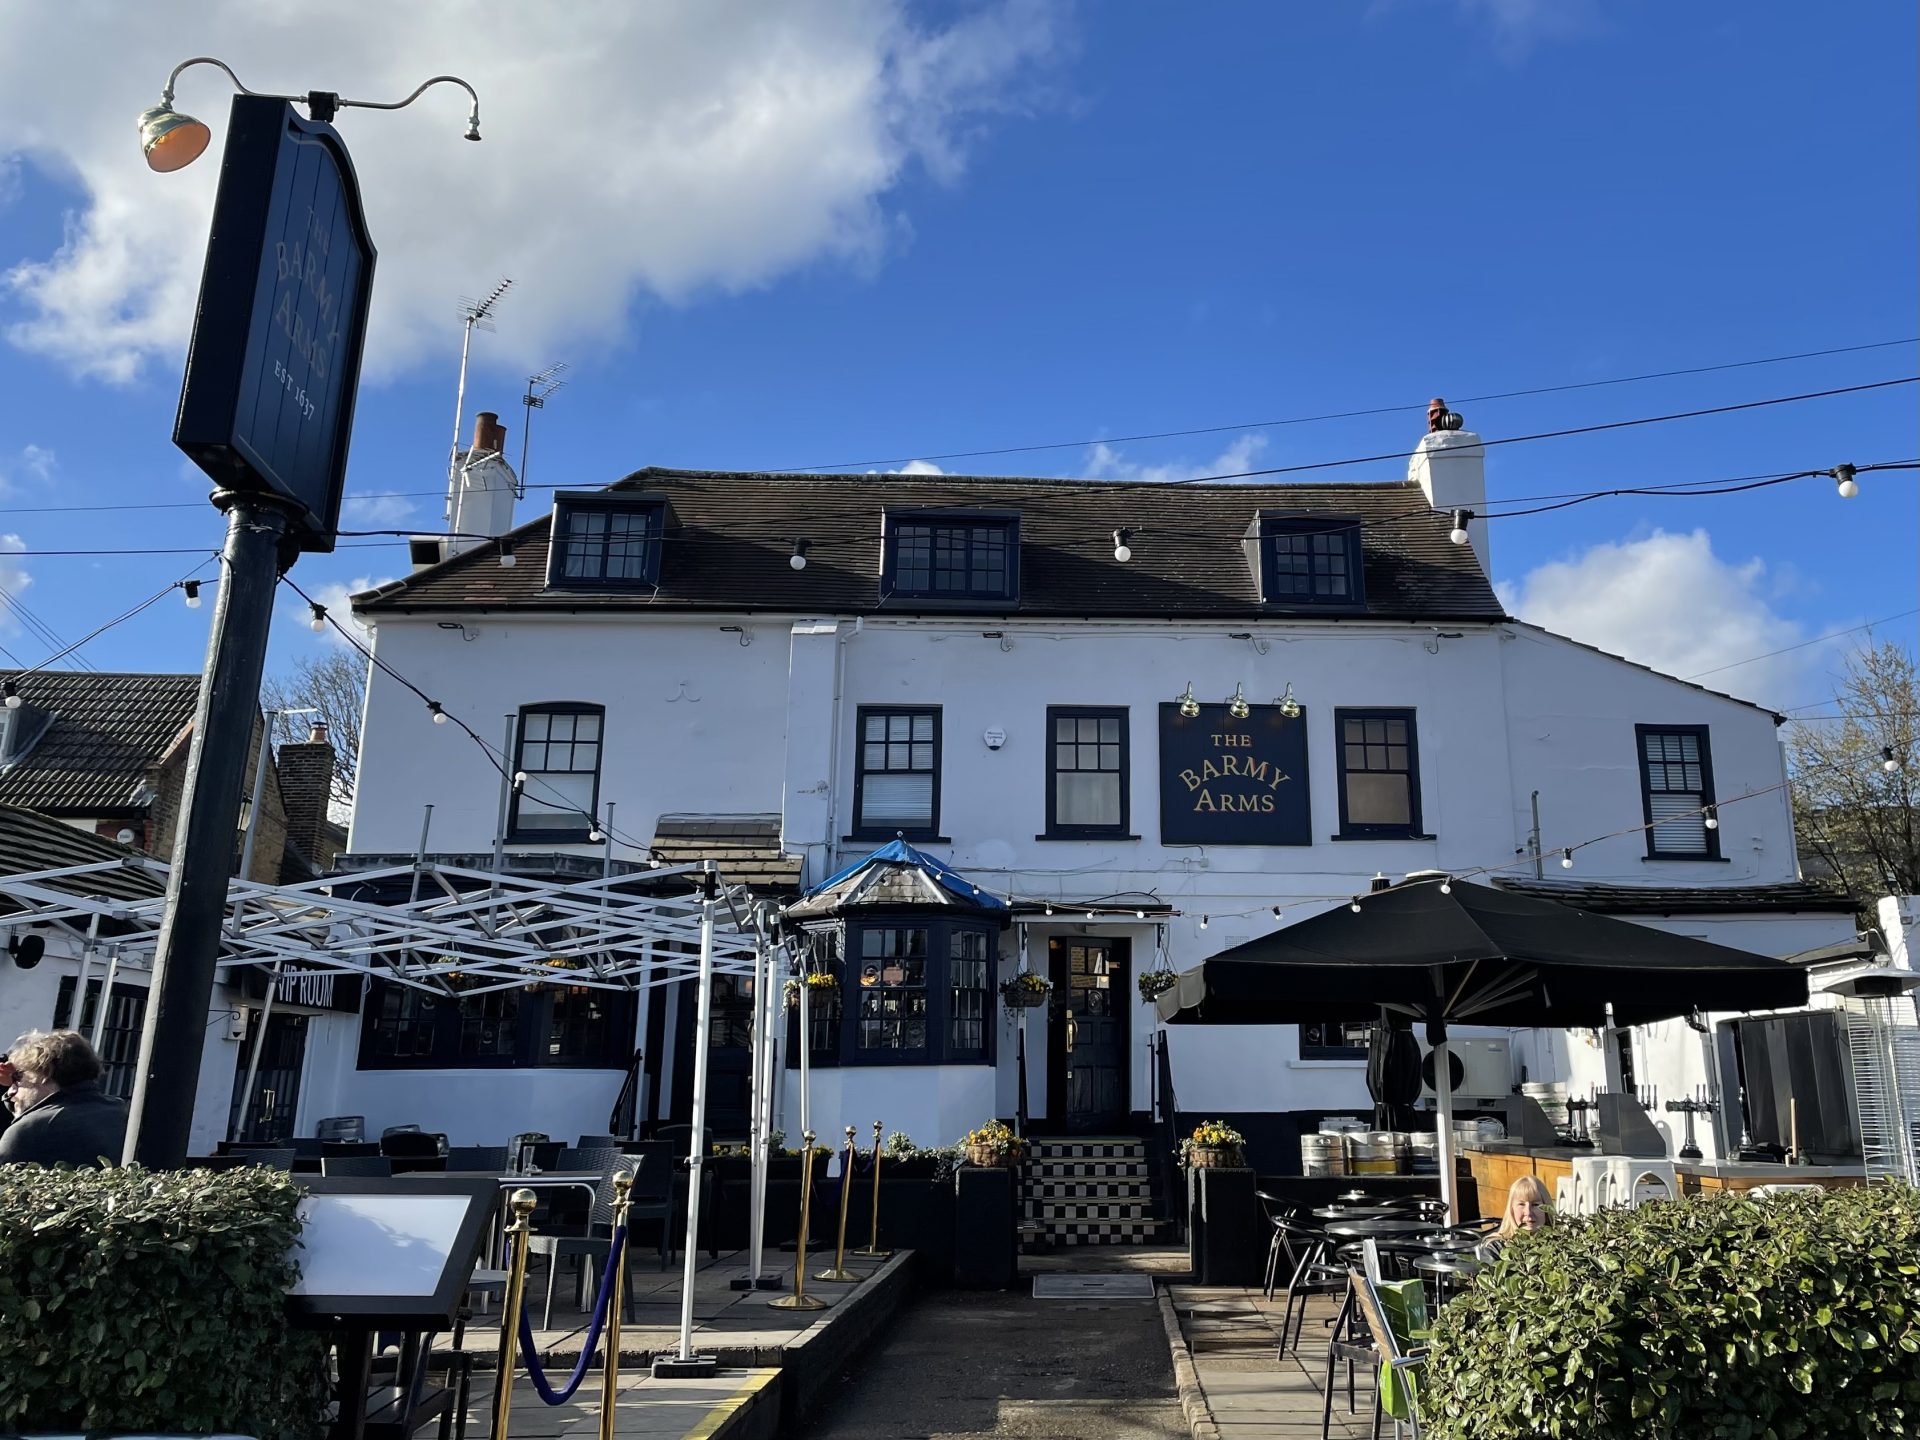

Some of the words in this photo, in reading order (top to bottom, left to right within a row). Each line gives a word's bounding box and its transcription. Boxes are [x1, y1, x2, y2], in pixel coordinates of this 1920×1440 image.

[307, 205, 330, 256] THE
[276, 241, 340, 345] BARMY
[275, 290, 326, 378] ARMS
[274, 360, 294, 391] EST
[295, 386, 315, 420] 1637
[1211, 734, 1252, 747] THE
[1178, 755, 1292, 792] BARMY
[1193, 788, 1276, 812] ARMS
[278, 964, 297, 1003] VIP
[300, 967, 334, 1008] ROOM
